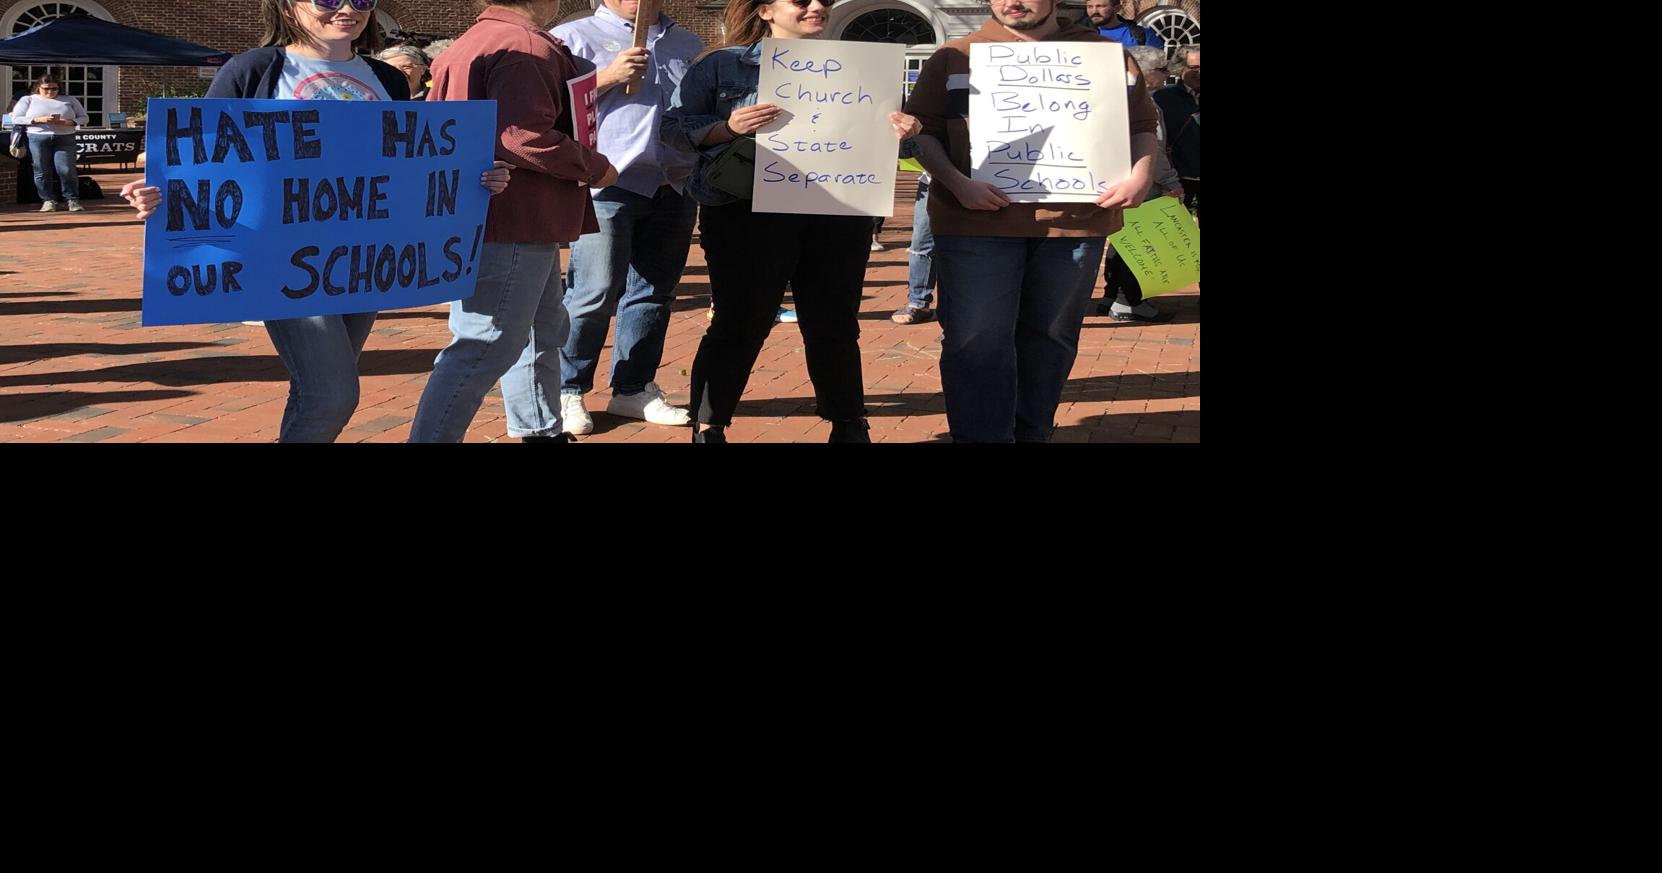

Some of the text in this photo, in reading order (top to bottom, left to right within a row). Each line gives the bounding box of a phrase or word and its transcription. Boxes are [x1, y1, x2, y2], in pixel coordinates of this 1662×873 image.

[771, 48, 842, 79] Keep
[988, 45, 1082, 65] Public
[999, 65, 1092, 86] Dollars
[775, 82, 873, 104] Church
[991, 91, 1092, 120] Belong
[166, 107, 322, 166] HATE
[997, 116, 1045, 133] In
[768, 134, 853, 152] State
[986, 140, 1084, 161] Public
[763, 161, 882, 188] Separate
[166, 168, 460, 232] NO HOME IN
[166, 223, 484, 299] OUR SCHOOLS!
